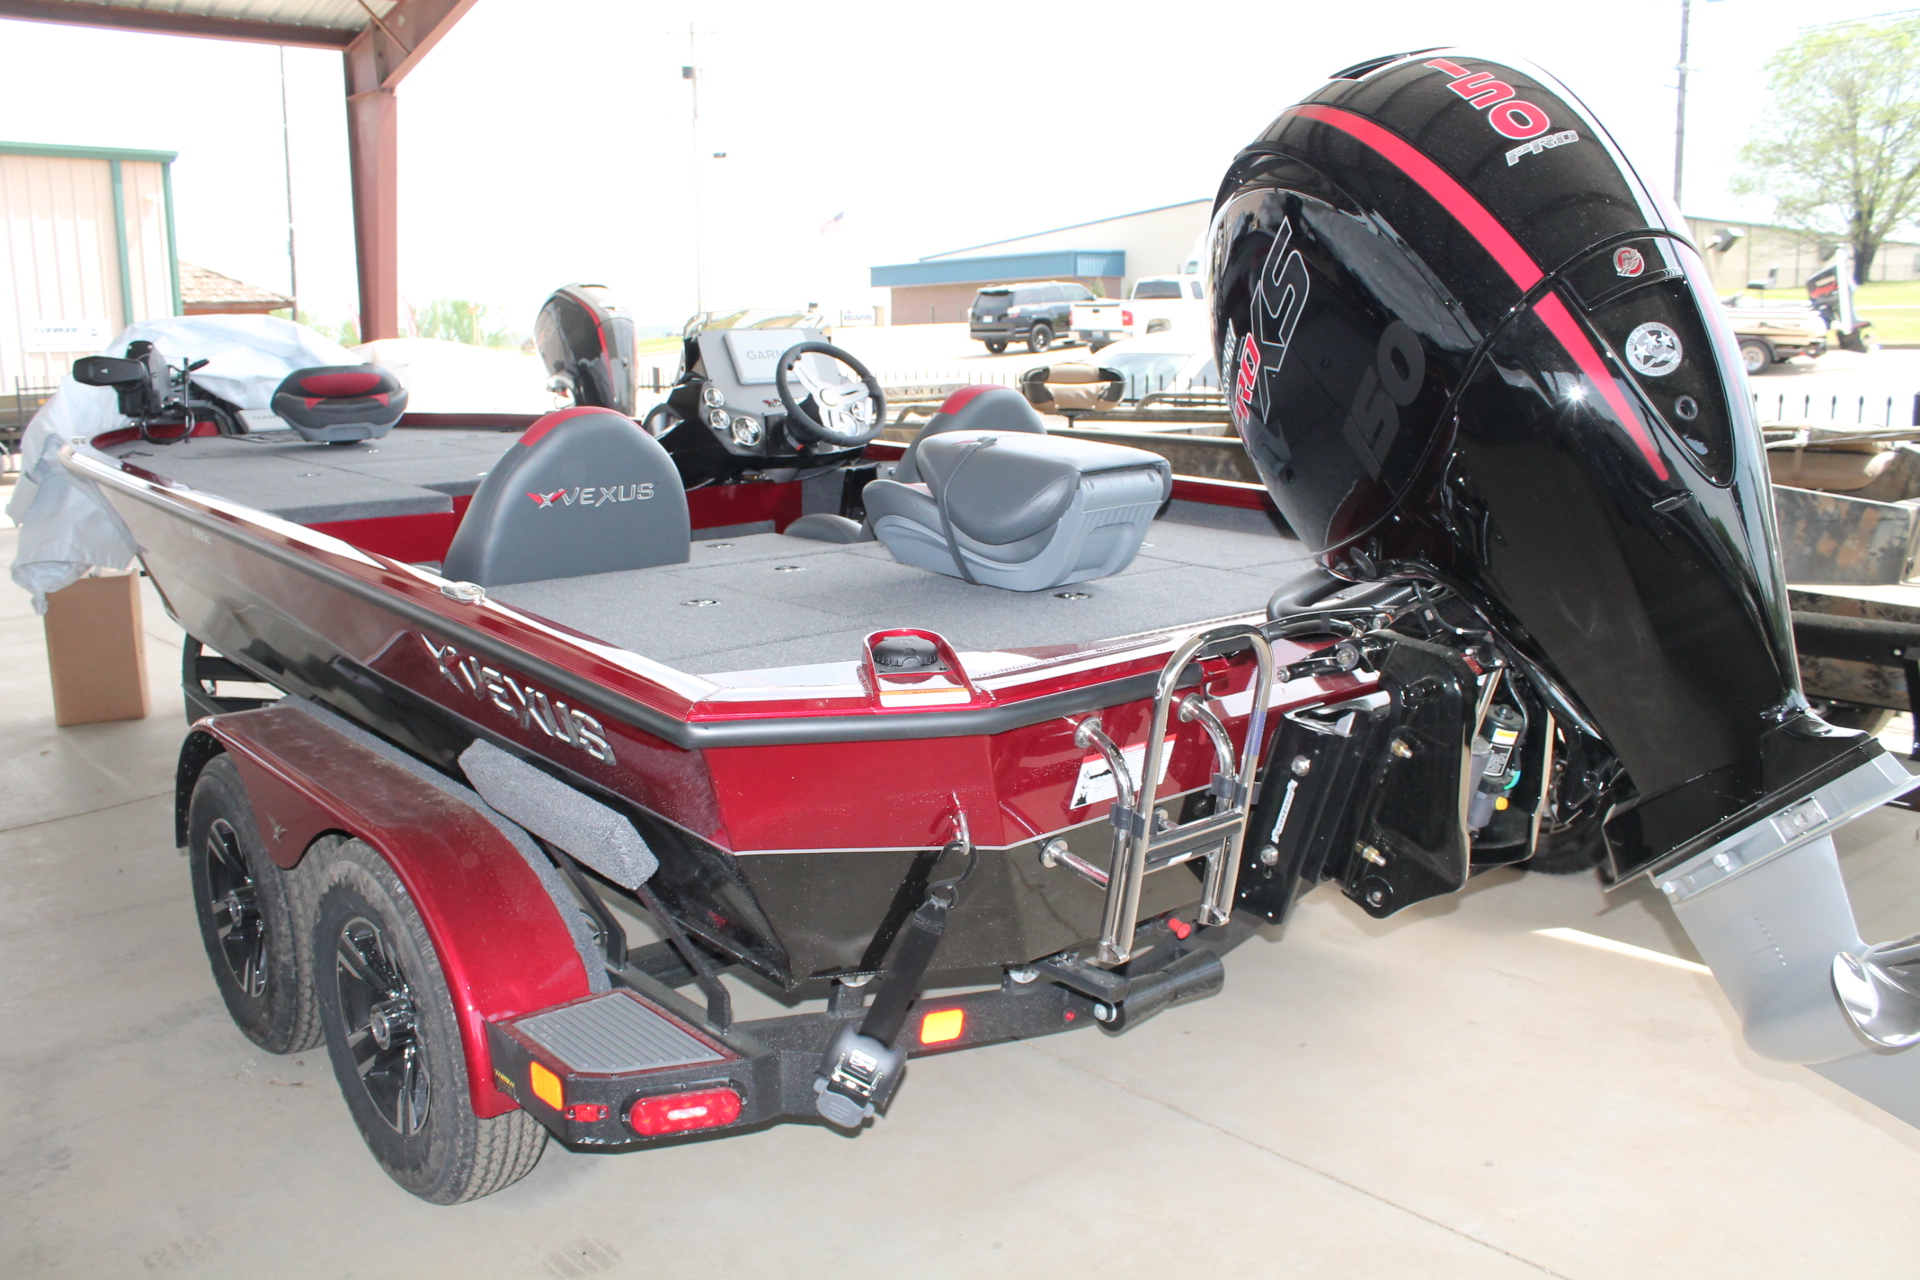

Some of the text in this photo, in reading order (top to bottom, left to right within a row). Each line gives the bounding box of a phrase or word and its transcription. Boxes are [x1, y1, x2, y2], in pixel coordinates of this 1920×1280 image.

[1423, 58, 1551, 140] 150
[1505, 130, 1580, 167] PRO
[1233, 215, 1310, 446] PRO XS
[1342, 319, 1426, 483] 150
[558, 483, 655, 507] VEXUS
[459, 655, 617, 767] VEXUS
[1124, 743, 1146, 753] DANGER
